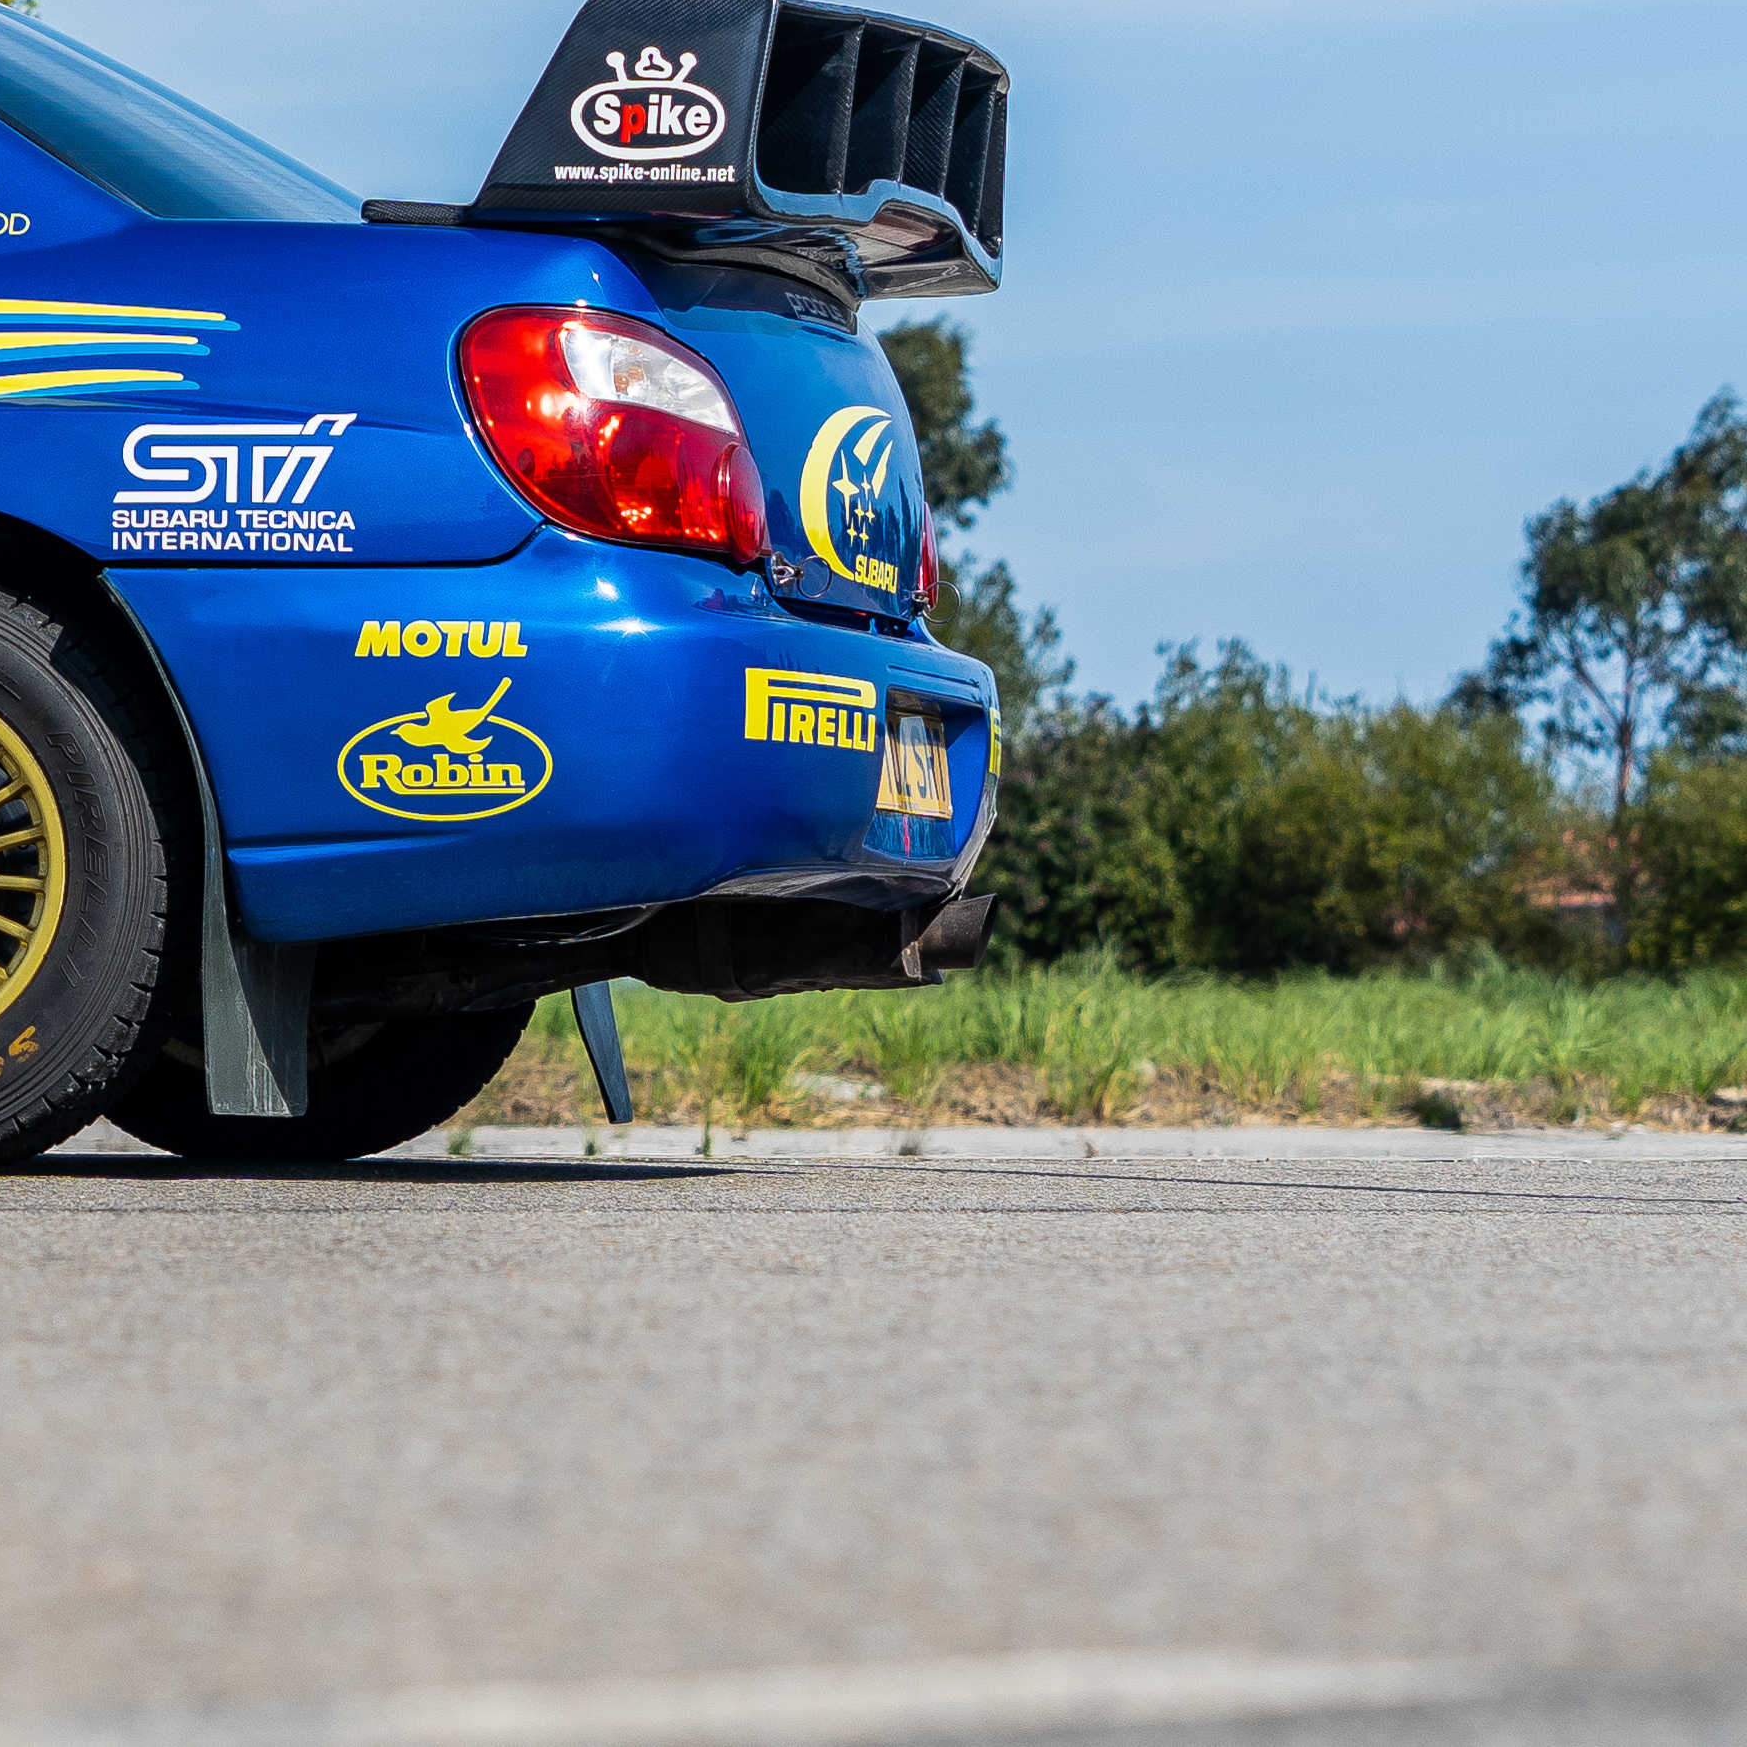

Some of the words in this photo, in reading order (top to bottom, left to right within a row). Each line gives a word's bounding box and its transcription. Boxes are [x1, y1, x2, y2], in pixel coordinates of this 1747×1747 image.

[593, 93, 711, 143] Spike
[554, 163, 736, 183] www.spike-online.net
[112, 509, 228, 529] SUBARU
[236, 510, 355, 530] TECNICA
[112, 532, 353, 552] INTERNATIONAL
[854, 554, 898, 594] SUBARU
[355, 620, 528, 657] MOTUL
[744, 667, 876, 752] PIRELLI
[360, 754, 525, 795] Robin
[44, 732, 109, 989] PIRELLI
